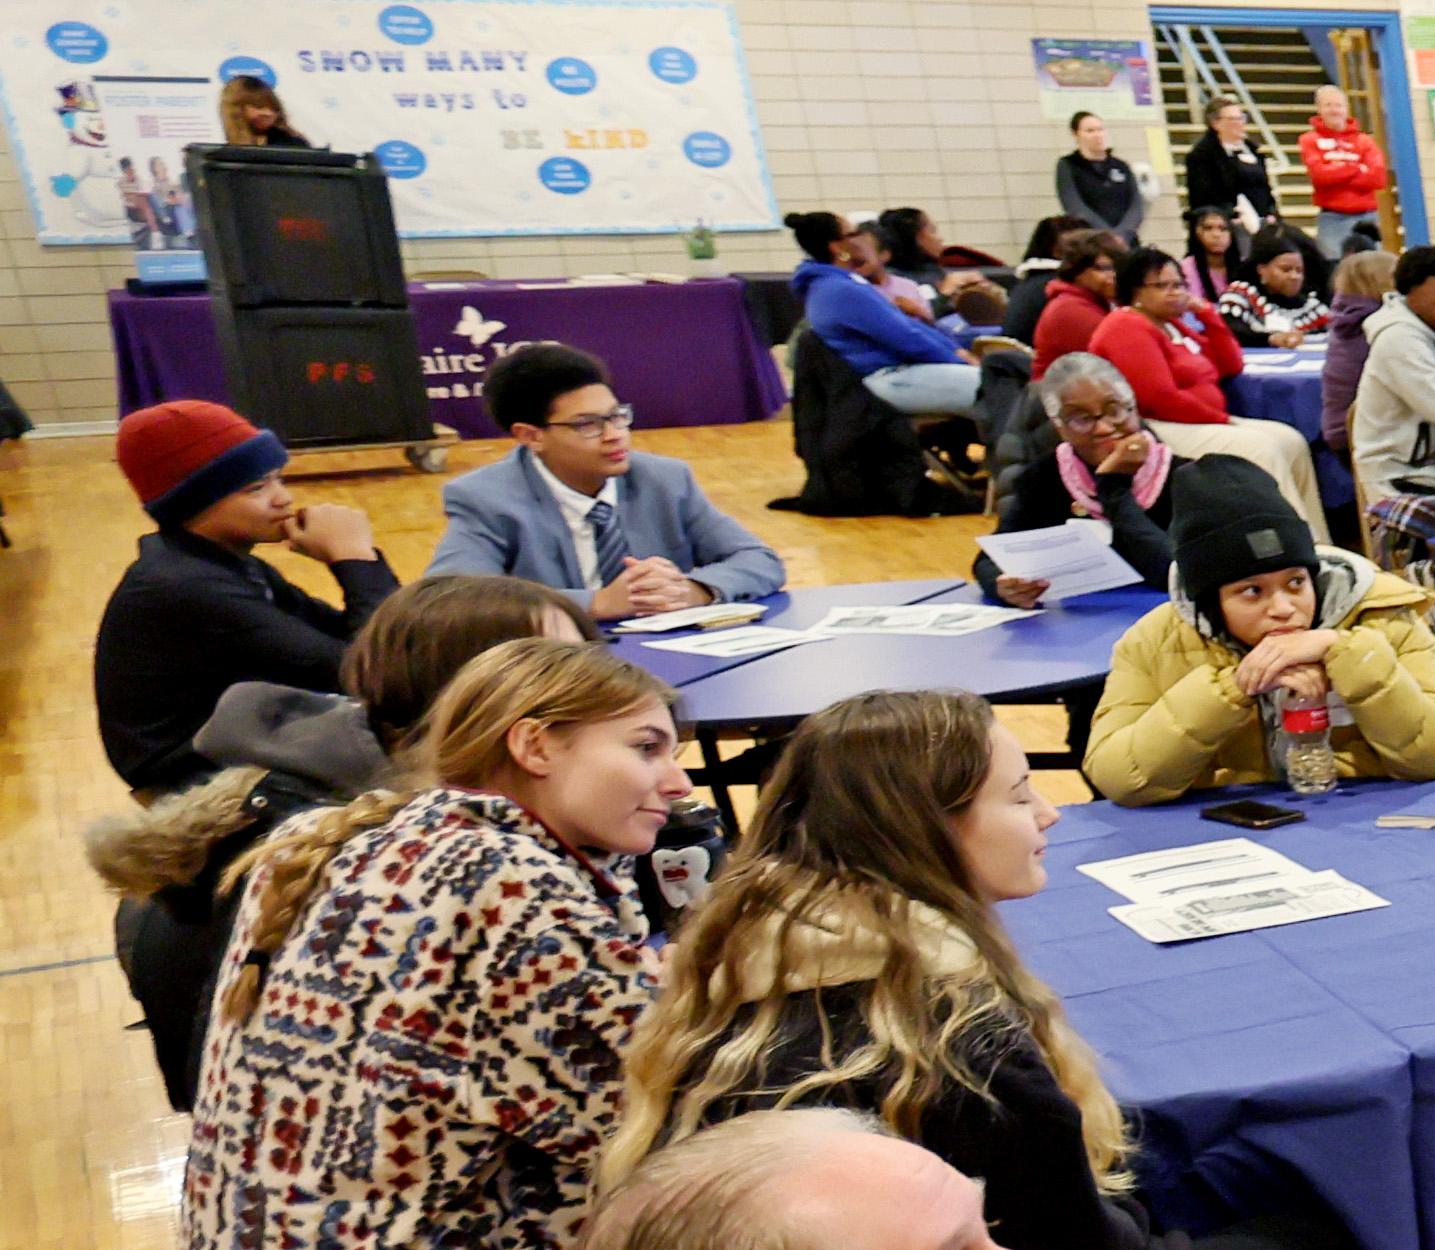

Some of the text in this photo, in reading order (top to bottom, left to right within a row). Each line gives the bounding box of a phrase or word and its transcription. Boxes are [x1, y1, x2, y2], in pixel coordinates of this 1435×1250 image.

[297, 50, 527, 72] SNOW MANY
[393, 89, 527, 112] ways to
